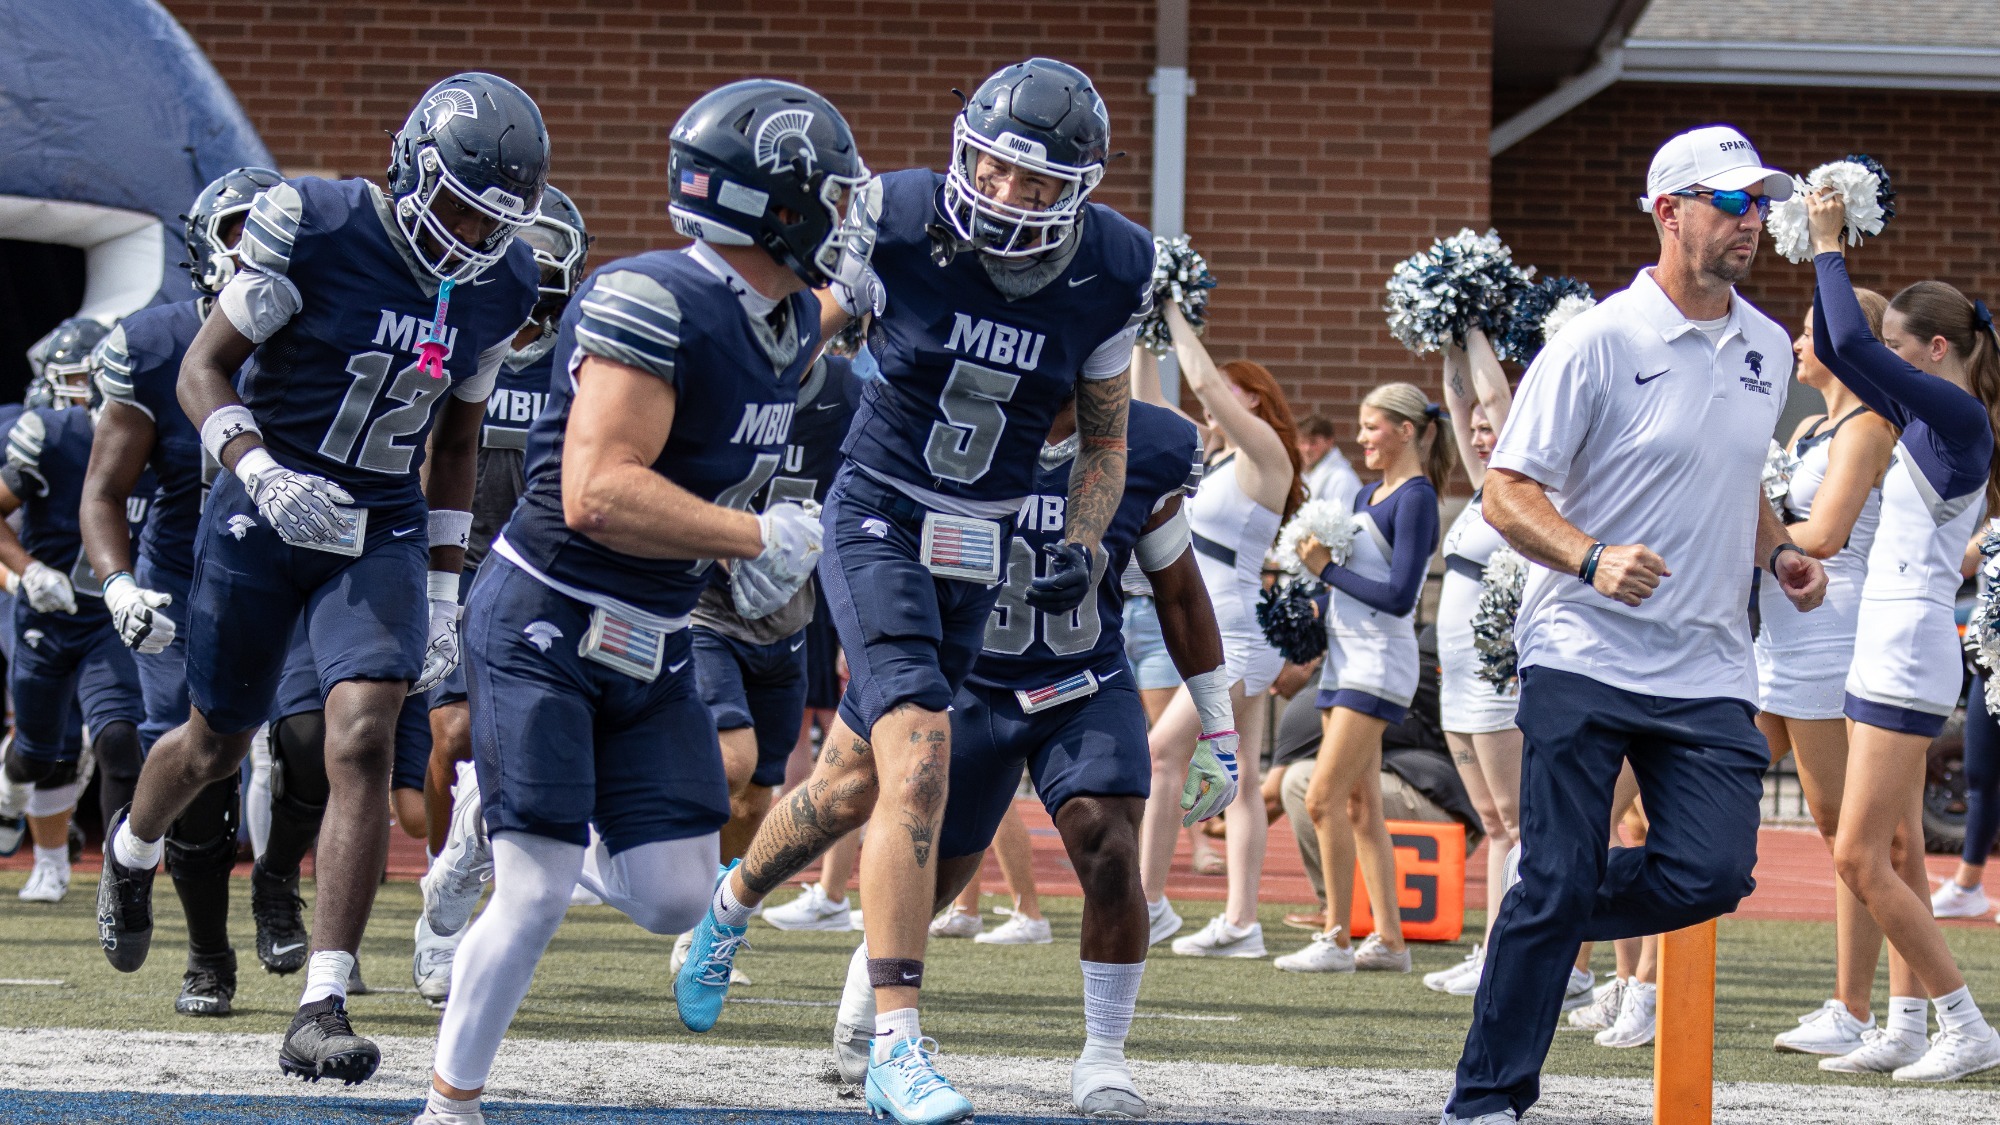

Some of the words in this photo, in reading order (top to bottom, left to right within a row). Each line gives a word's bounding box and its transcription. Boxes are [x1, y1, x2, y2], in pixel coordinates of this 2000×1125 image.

[1009, 137, 1032, 154] MBU
[497, 193, 516, 208] MBU
[674, 215, 704, 239] TANS
[944, 312, 1046, 371] MBU
[317, 350, 451, 474] 12
[486, 388, 551, 422] MBU
[729, 402, 796, 445] MBU
[923, 359, 1021, 485] 5
[1017, 494, 1069, 532] MB
[1370, 833, 1438, 923] G
